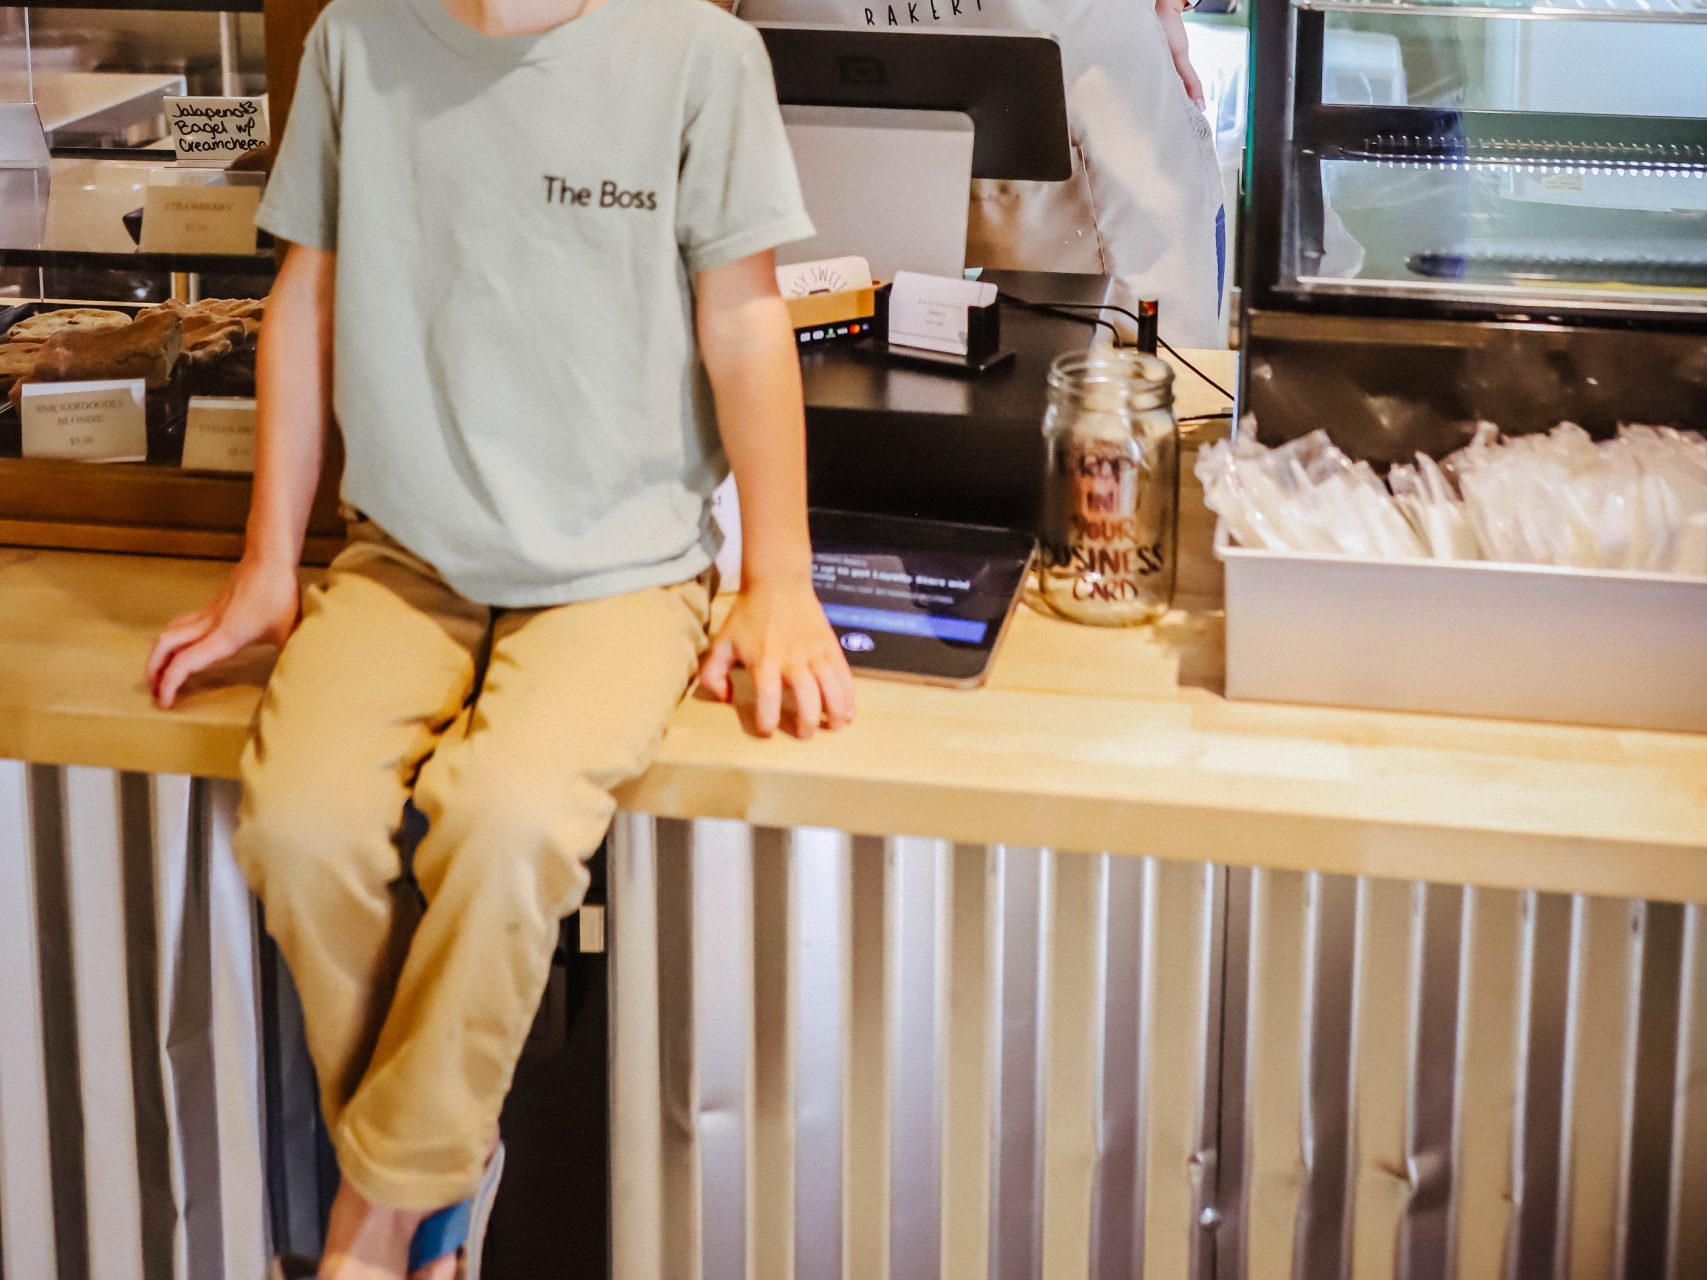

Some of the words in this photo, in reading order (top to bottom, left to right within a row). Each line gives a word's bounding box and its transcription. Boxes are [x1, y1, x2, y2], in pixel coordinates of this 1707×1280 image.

[174, 120, 228, 139] Bagel
[543, 175, 591, 206] The
[600, 180, 657, 210] Boss
[1073, 579, 1139, 602] CARD
